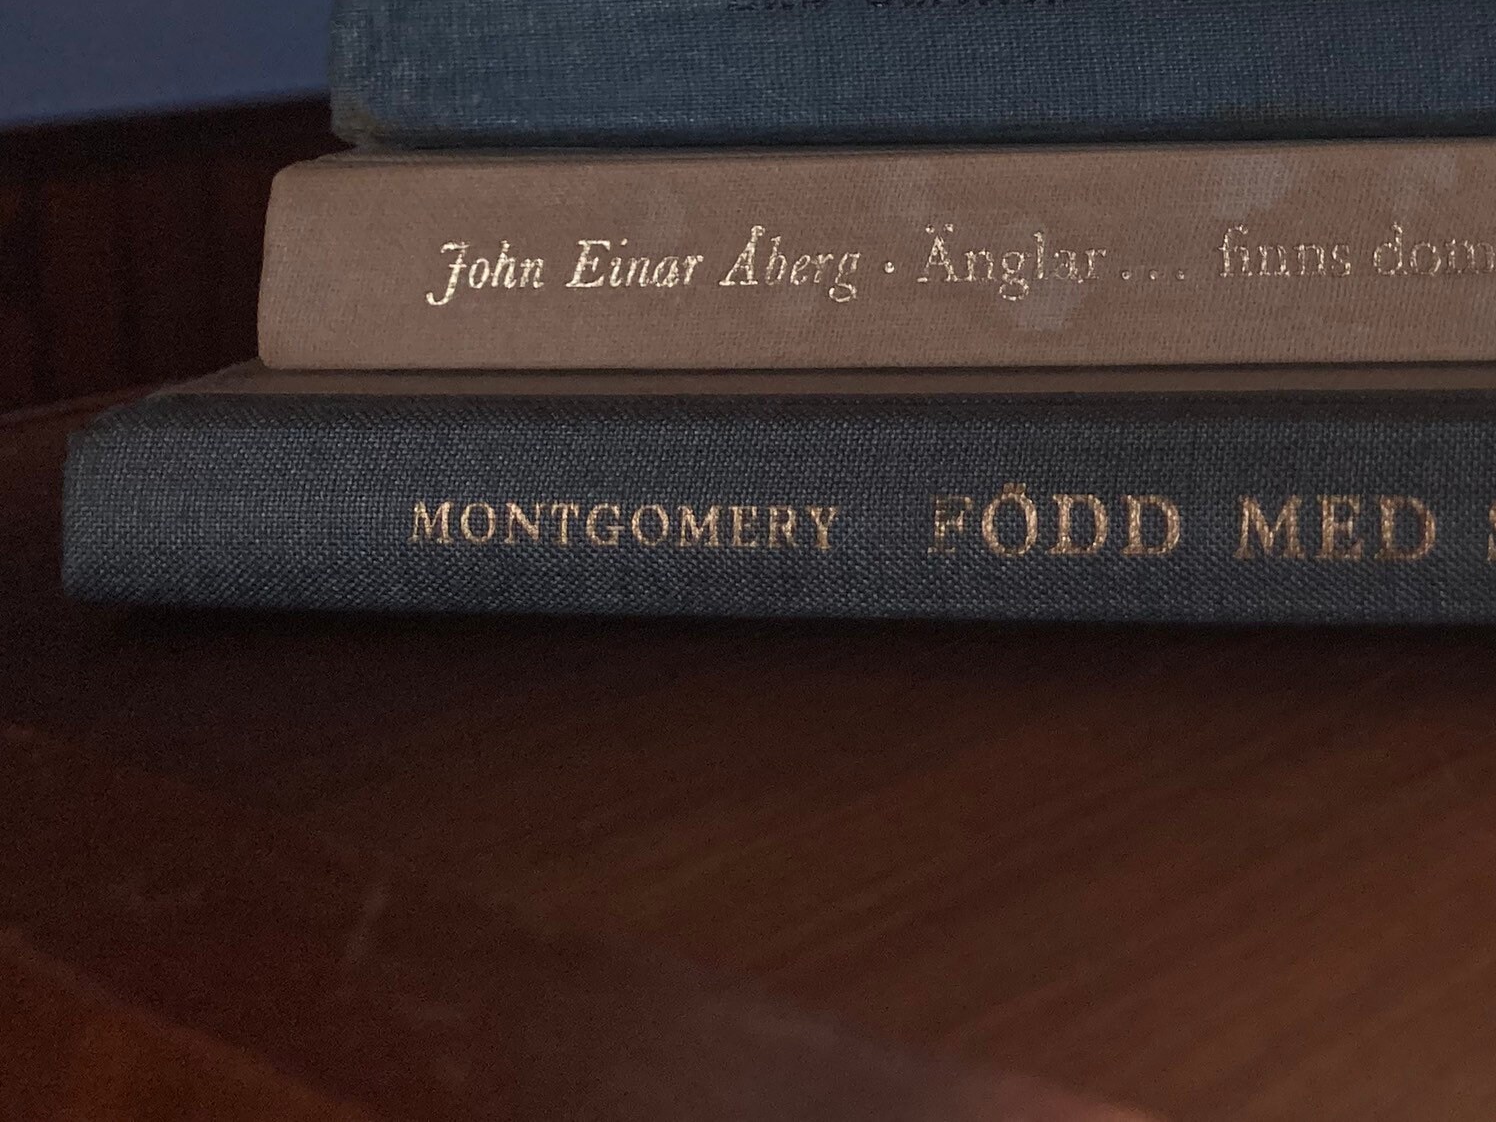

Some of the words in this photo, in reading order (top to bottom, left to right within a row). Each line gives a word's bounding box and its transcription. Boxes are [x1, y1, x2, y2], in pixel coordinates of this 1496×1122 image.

[425, 240, 545, 306] John
[564, 237, 704, 289] Einar
[718, 225, 861, 302] Åberg
[1217, 224, 1352, 278] finns
[408, 500, 840, 549] MONTGOMERY
[926, 482, 1182, 558] FÖDD
[1232, 494, 1438, 561] MED
